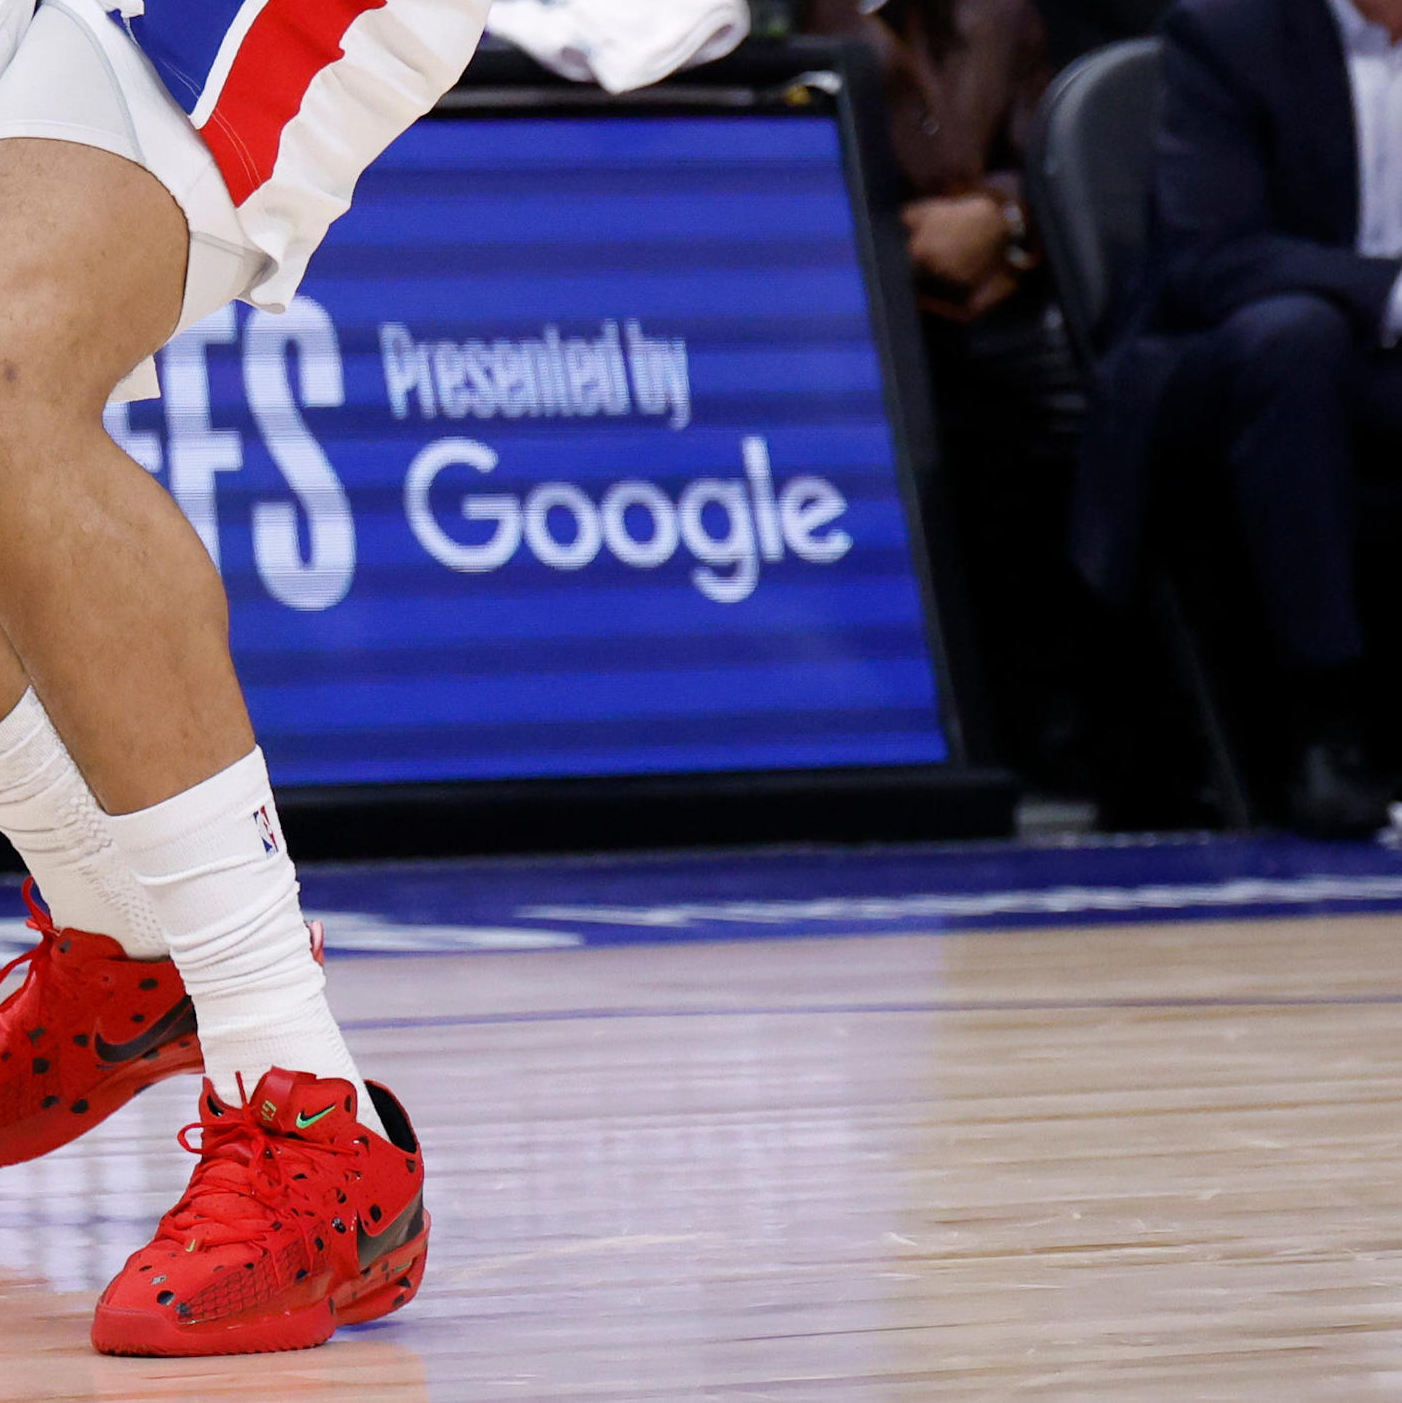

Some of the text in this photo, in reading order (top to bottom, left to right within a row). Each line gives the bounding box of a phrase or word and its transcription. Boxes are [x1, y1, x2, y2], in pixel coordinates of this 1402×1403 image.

[377, 318, 693, 432] Presented by
[403, 435, 855, 604] Google
